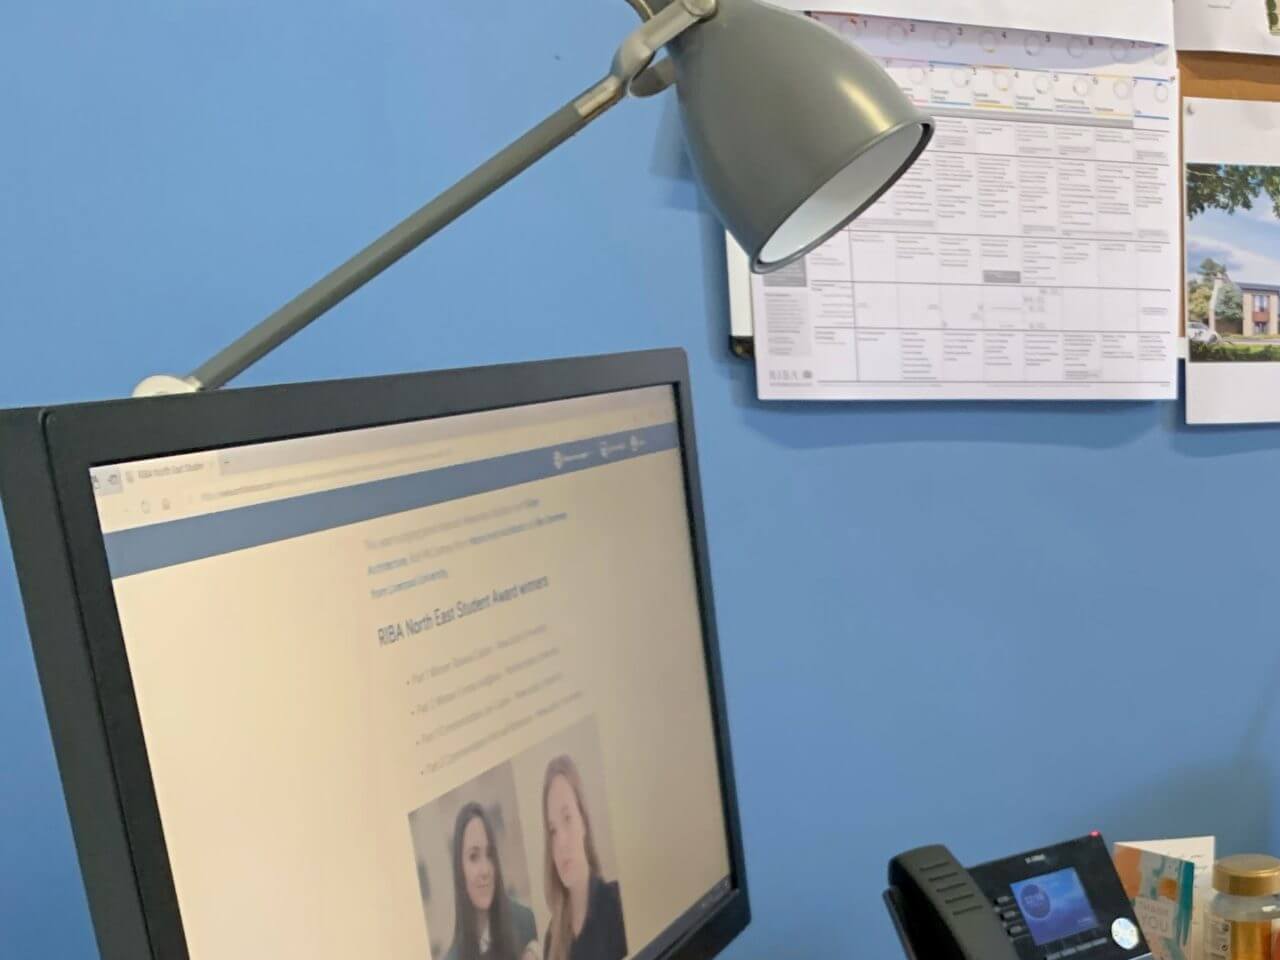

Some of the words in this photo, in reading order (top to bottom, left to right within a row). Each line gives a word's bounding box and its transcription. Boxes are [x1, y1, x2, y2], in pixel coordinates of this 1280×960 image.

[377, 623, 405, 647] RIBA
[405, 616, 434, 639] North
[433, 607, 456, 627] East
[455, 594, 492, 619] Student
